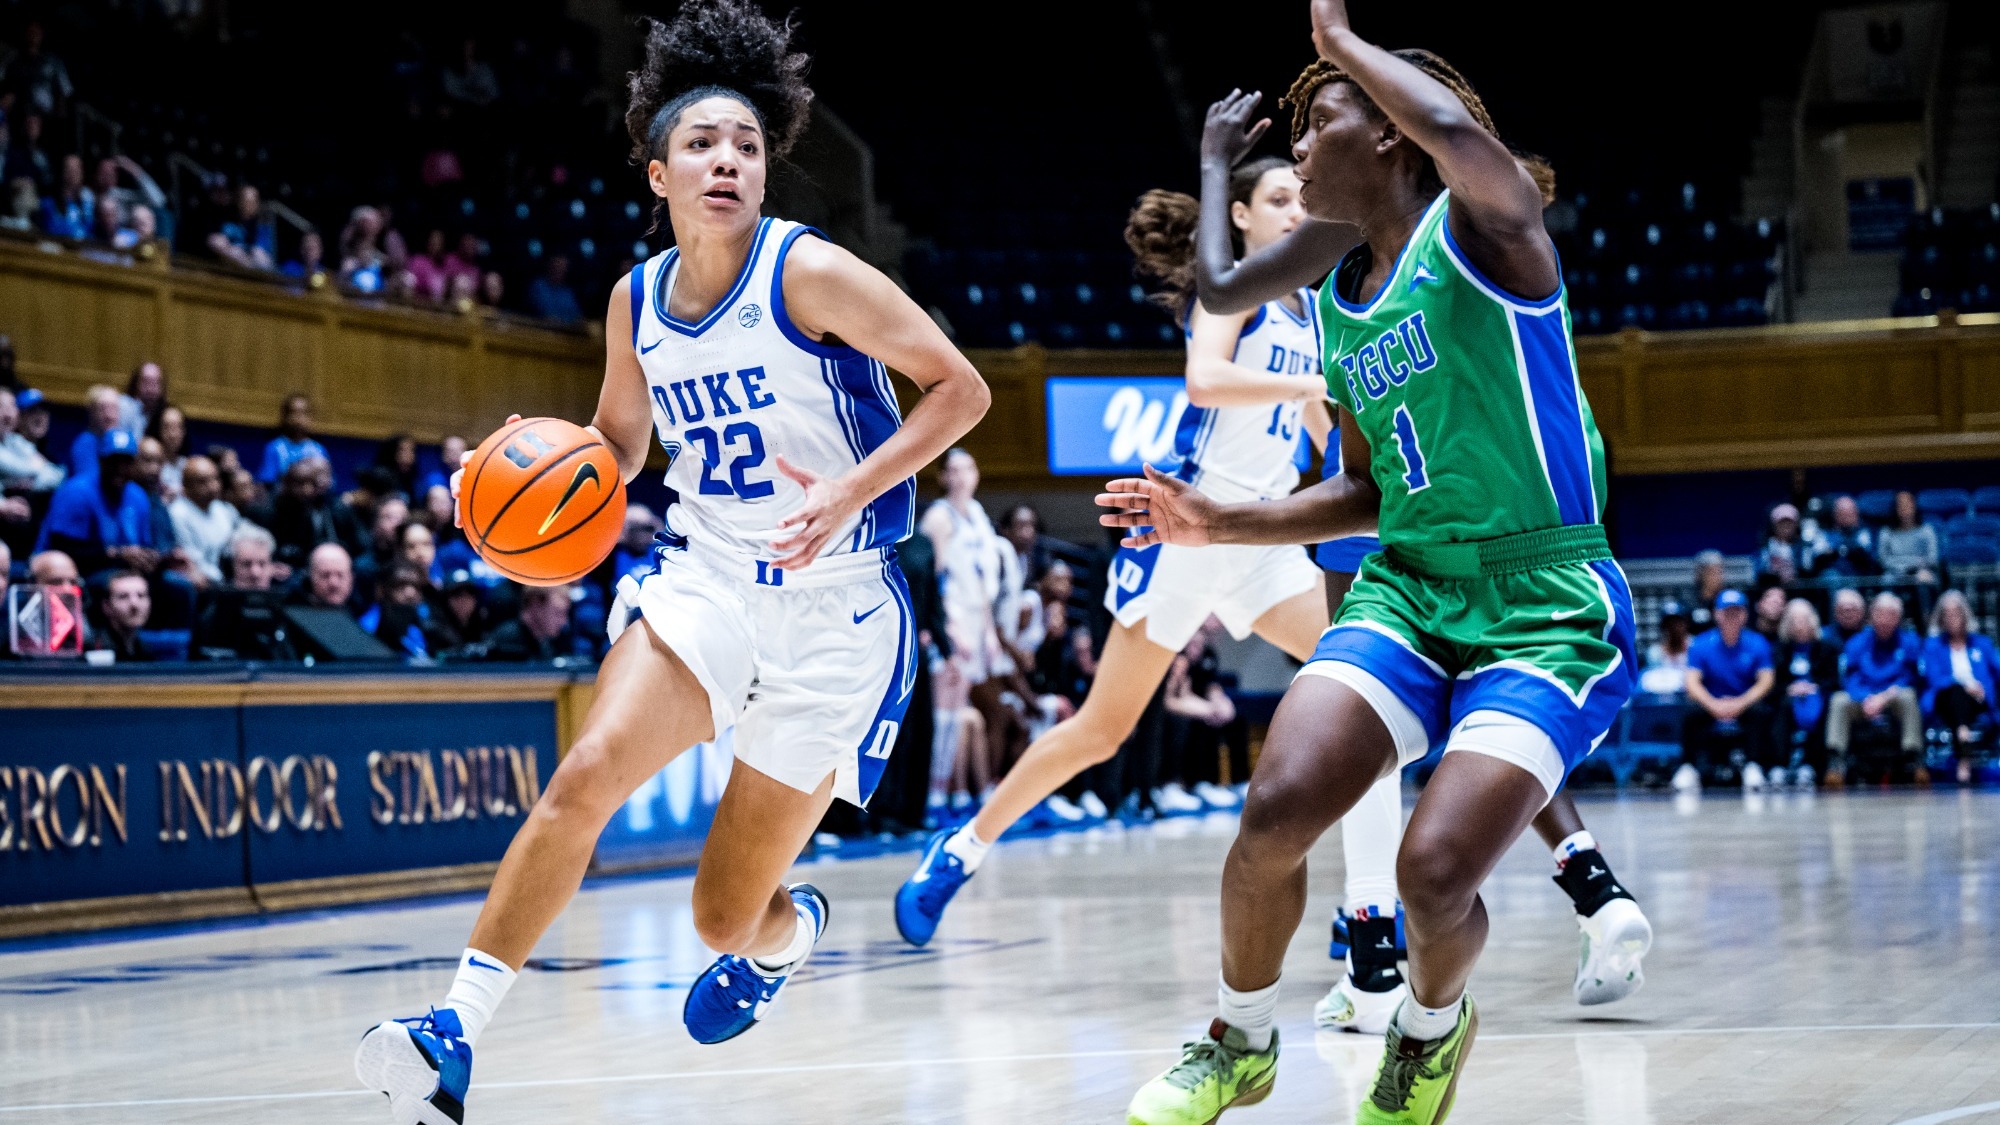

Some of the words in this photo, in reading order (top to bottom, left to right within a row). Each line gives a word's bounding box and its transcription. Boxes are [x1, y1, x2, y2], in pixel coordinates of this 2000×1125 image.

[741, 310, 760, 320] ACC
[1266, 344, 1323, 375] DUK
[1338, 310, 1438, 414] FGCU
[651, 365, 777, 426] DUKE
[684, 421, 775, 500] 22
[1391, 401, 1431, 495] 1
[864, 719, 899, 760] D
[158, 754, 344, 841] INDOOR
[367, 745, 541, 825] STADIUM
